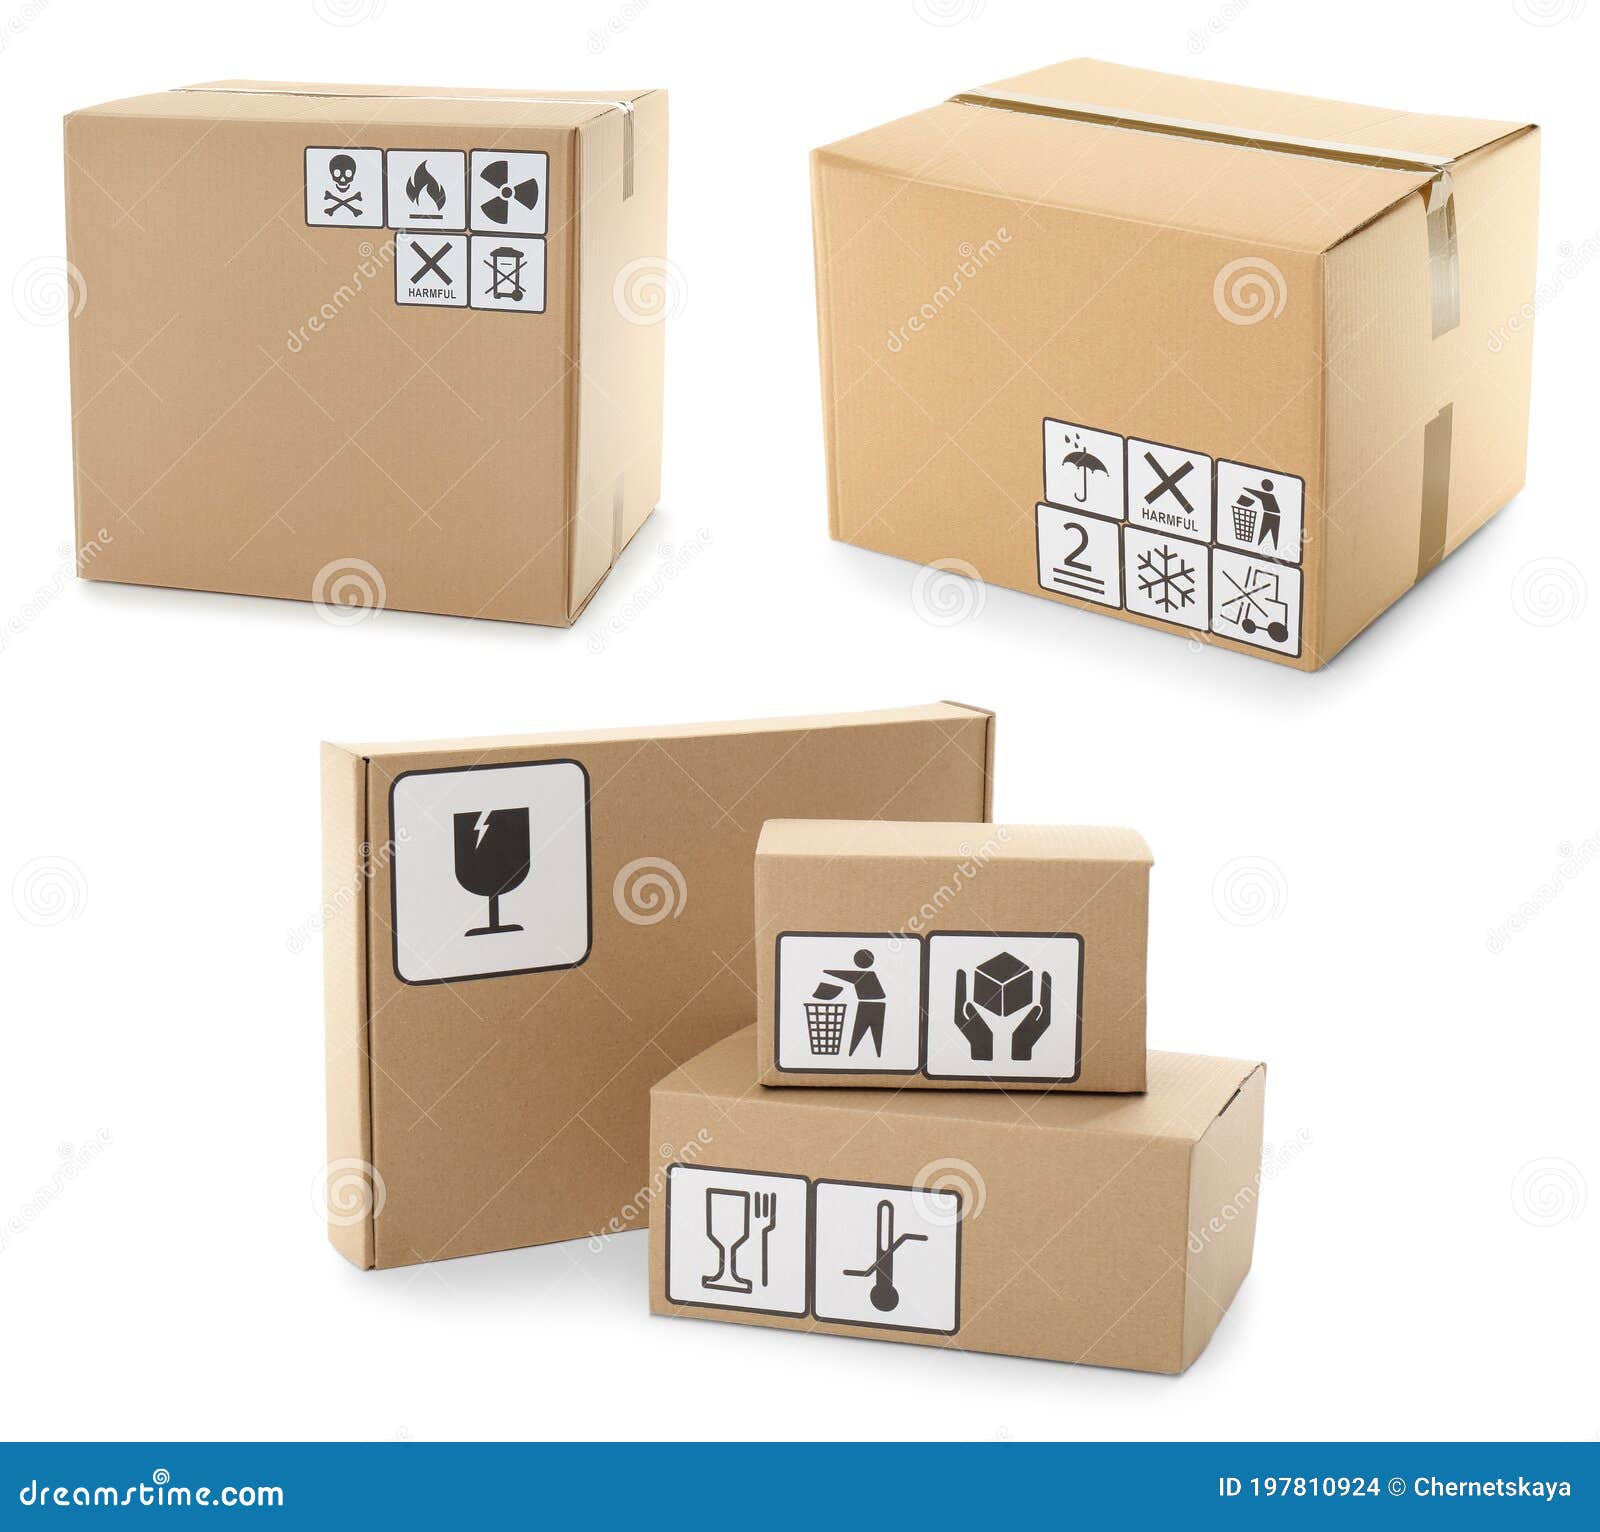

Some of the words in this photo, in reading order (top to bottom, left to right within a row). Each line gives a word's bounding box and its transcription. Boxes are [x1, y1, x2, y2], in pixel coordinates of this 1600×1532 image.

[408, 287, 457, 299] HARMFUL
[1141, 507, 1199, 533] HARMFUL
[1062, 521, 1092, 572] 2
